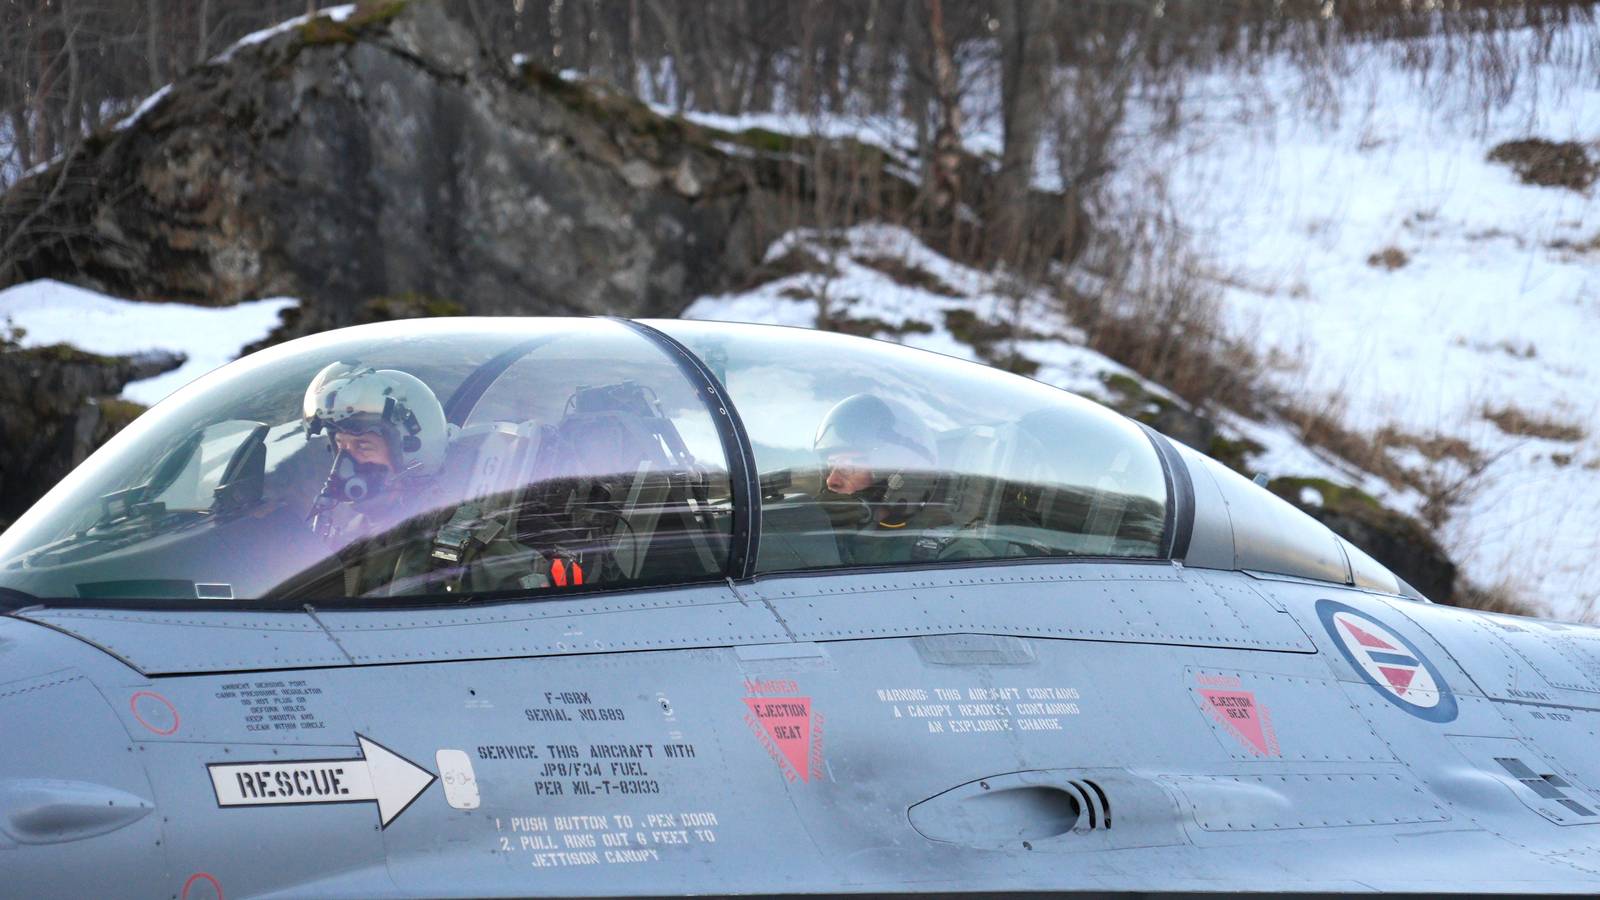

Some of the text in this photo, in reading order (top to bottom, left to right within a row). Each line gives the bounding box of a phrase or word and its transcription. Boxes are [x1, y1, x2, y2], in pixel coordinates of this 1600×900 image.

[934, 688, 961, 701] THIS
[1026, 688, 1080, 700] CONTAINS
[1209, 696, 1253, 708] EJECTION
[524, 708, 626, 722] SERIAL NO.689
[754, 704, 808, 718] EJECTION
[893, 706, 903, 718] A
[907, 704, 952, 718] CANOPY
[1016, 703, 1080, 716] CONTAINING
[1226, 708, 1250, 719] SEAT
[774, 726, 802, 740] SEAT
[928, 718, 1062, 733] AN EXPLOSIVE CHARGE
[477, 744, 696, 760] SERVICE THIS AIRCRAFT WITH
[540, 762, 648, 778] JP8/F34 FUEL
[235, 768, 350, 798] RESCUE
[534, 780, 660, 796] PER MIL-T-83133
[511, 816, 548, 832] PUSH
[554, 815, 609, 831] BUTTON
[613, 814, 634, 830] TO
[640, 813, 676, 828] PEN
[680, 812, 718, 827] DOOR
[500, 829, 716, 851] 2. PULL RING OUT 6 FEET TO
[532, 849, 659, 866] JETTISON CANOPY
